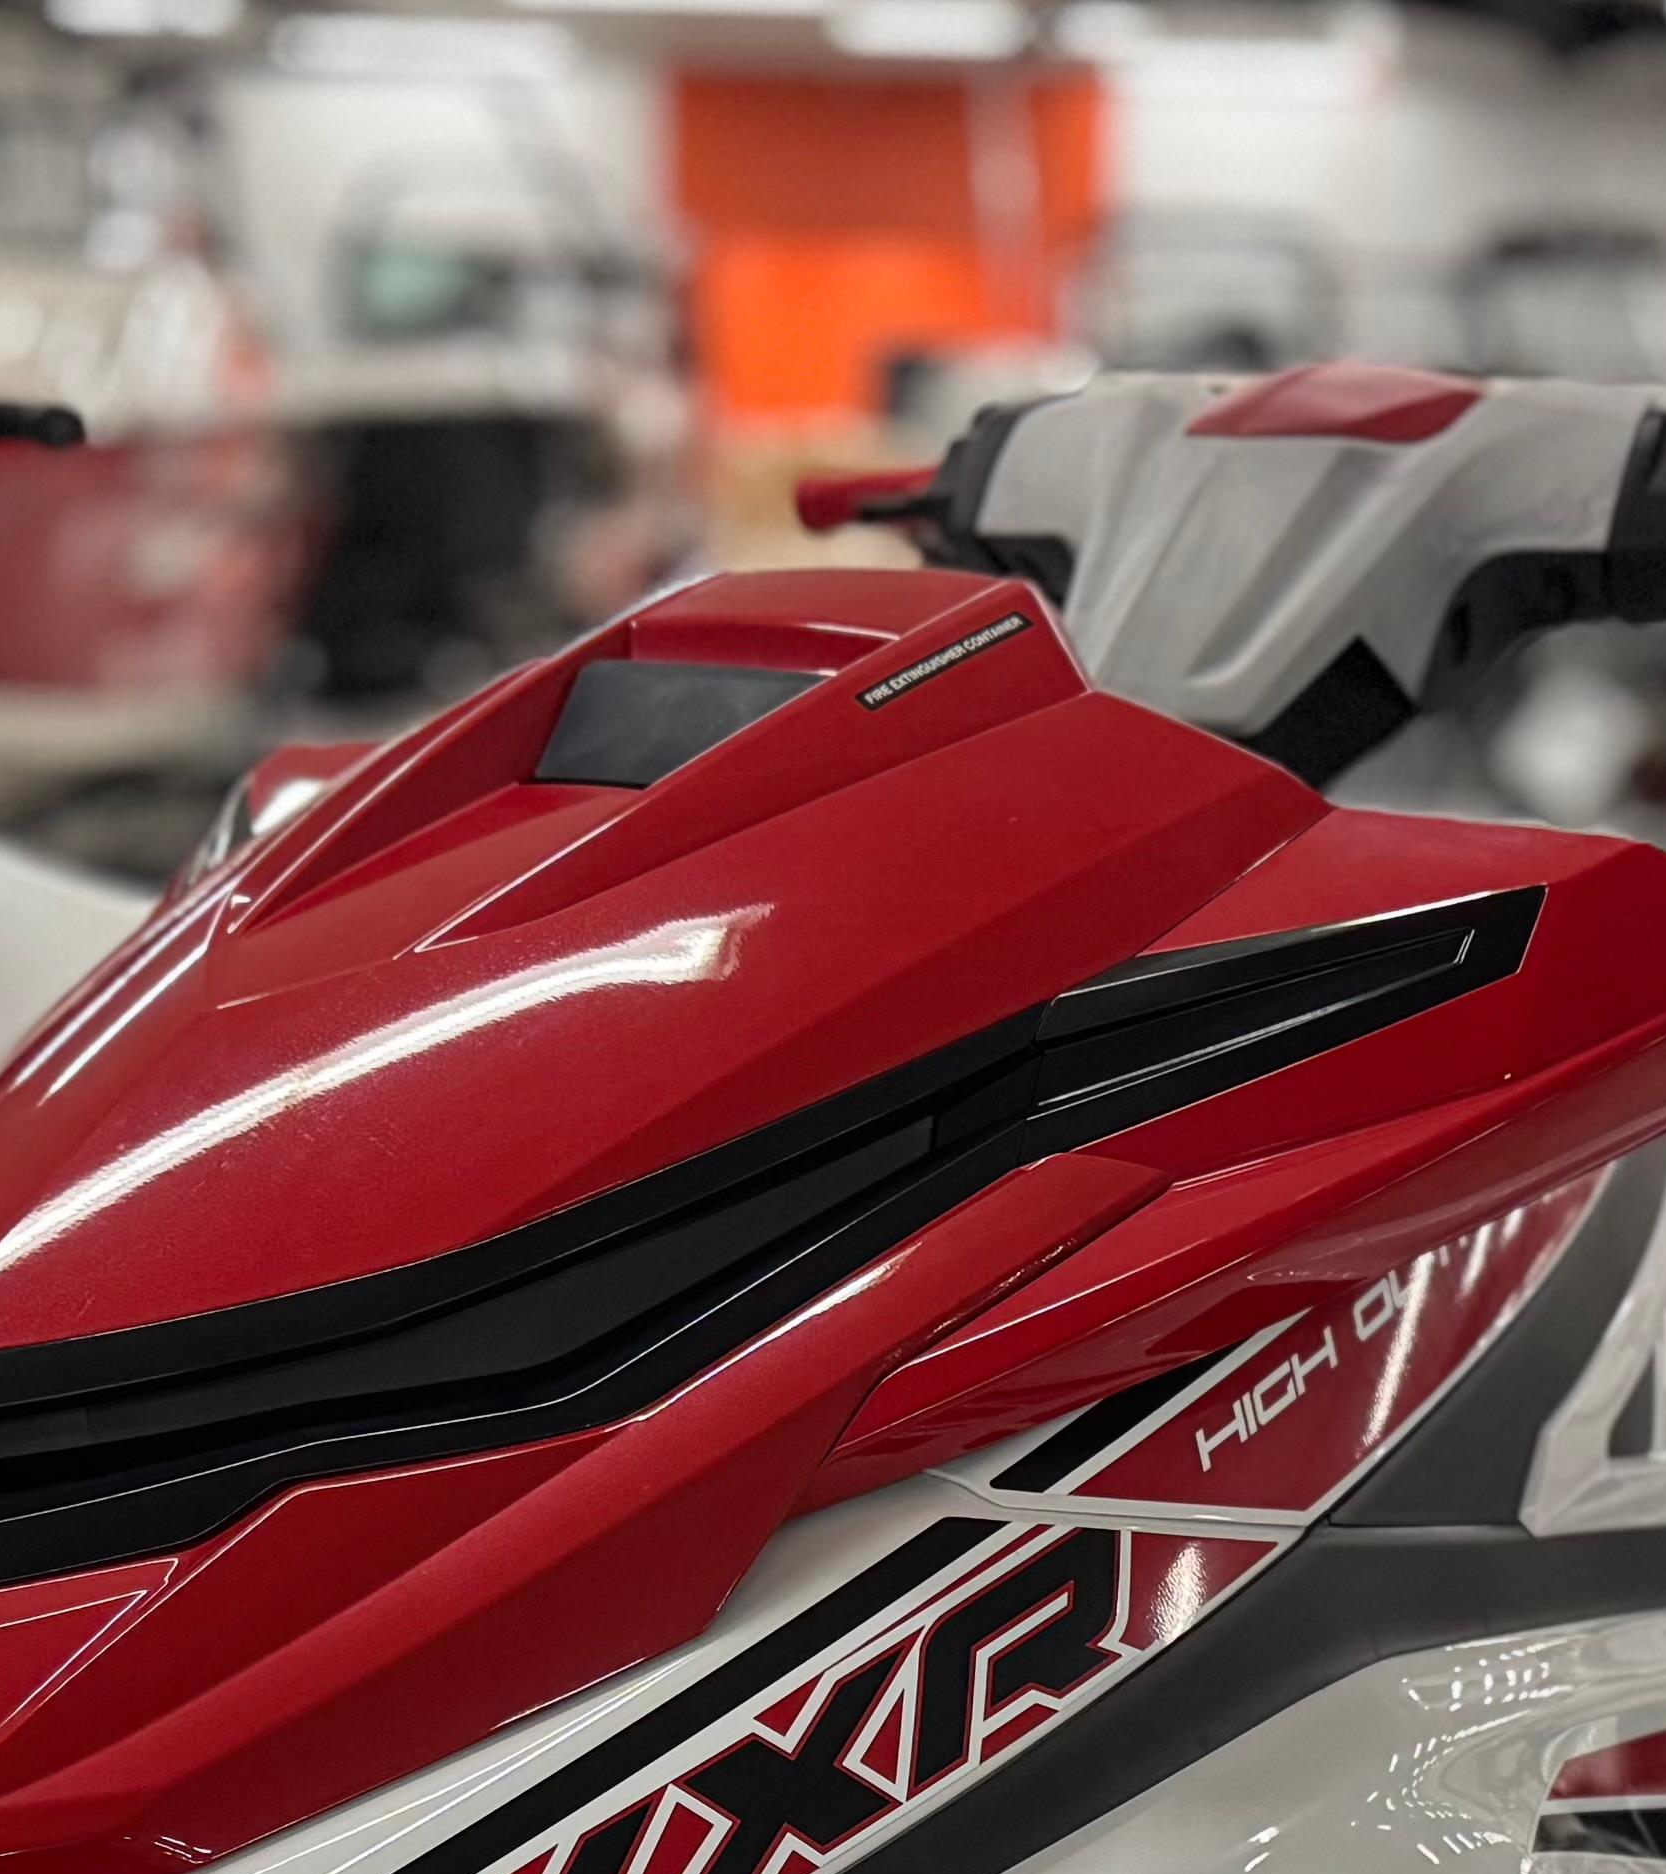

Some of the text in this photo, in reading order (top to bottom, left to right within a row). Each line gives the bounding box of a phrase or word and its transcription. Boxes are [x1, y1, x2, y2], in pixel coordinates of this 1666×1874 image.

[864, 615, 1024, 705] FIRE EXTINGUISHER CONTAINER
[1195, 1326, 1338, 1472] HIGH
